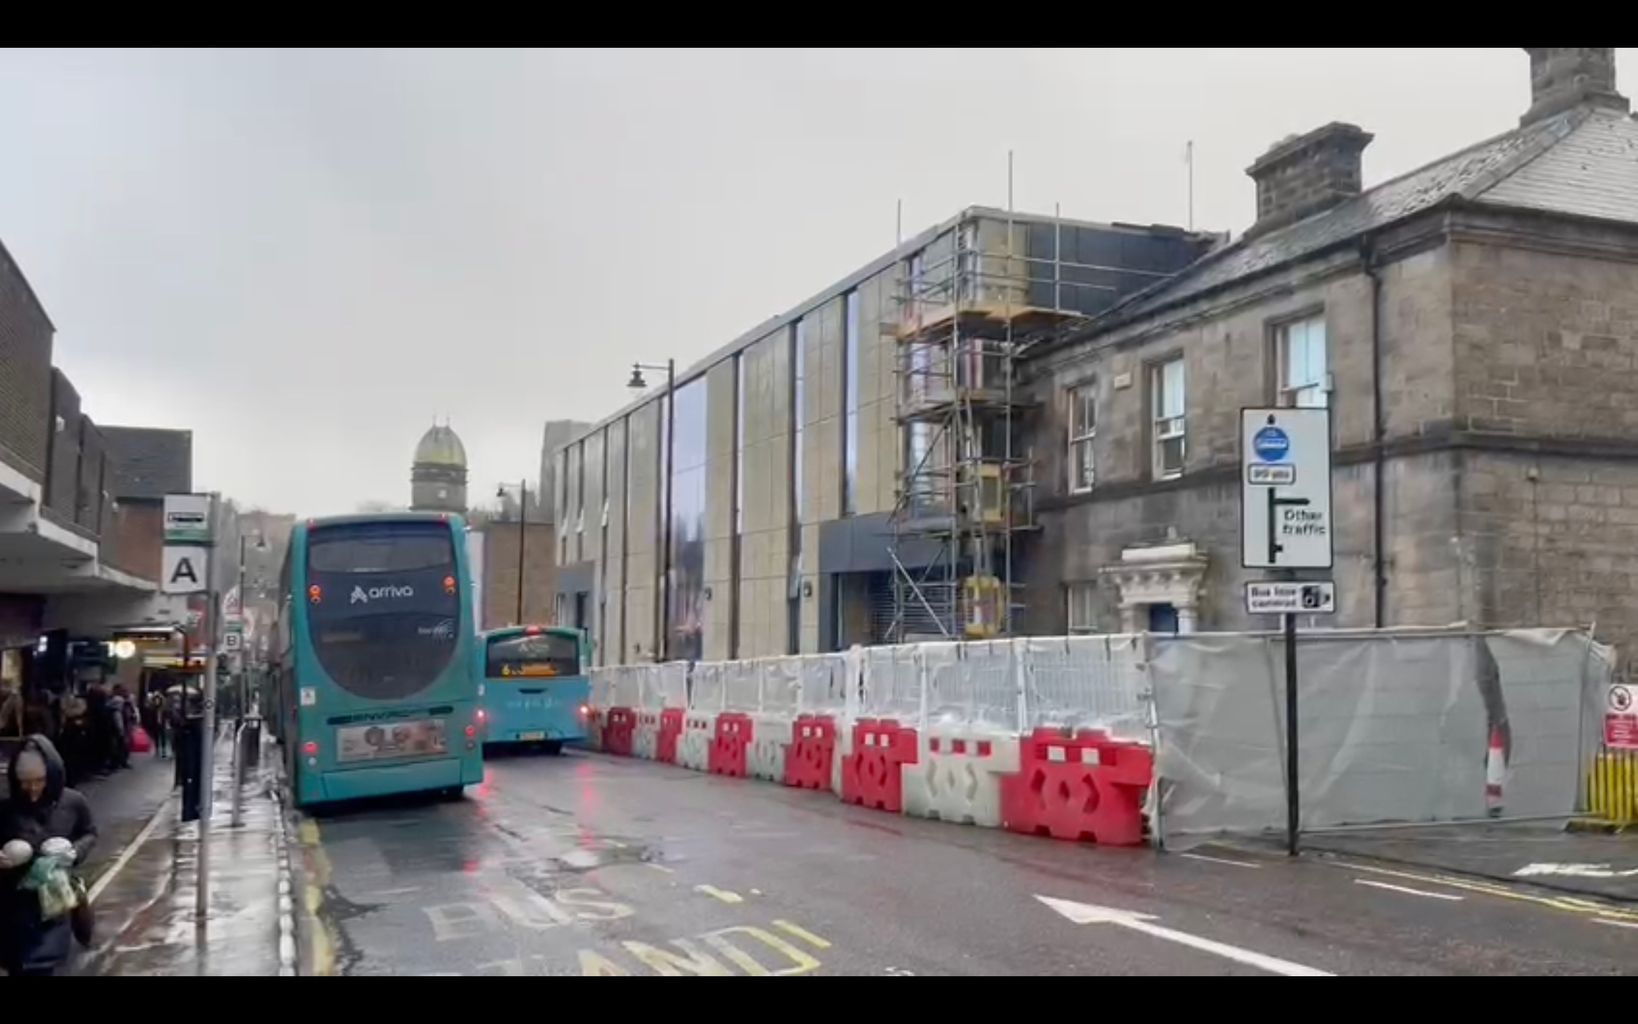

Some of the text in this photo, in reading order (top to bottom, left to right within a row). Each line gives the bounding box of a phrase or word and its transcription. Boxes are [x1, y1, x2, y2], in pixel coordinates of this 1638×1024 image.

[1284, 509, 1322, 520] Other
[1282, 524, 1326, 535] traffic
[170, 557, 198, 583] A
[368, 585, 414, 599] arriva
[226, 635, 237, 646] B
